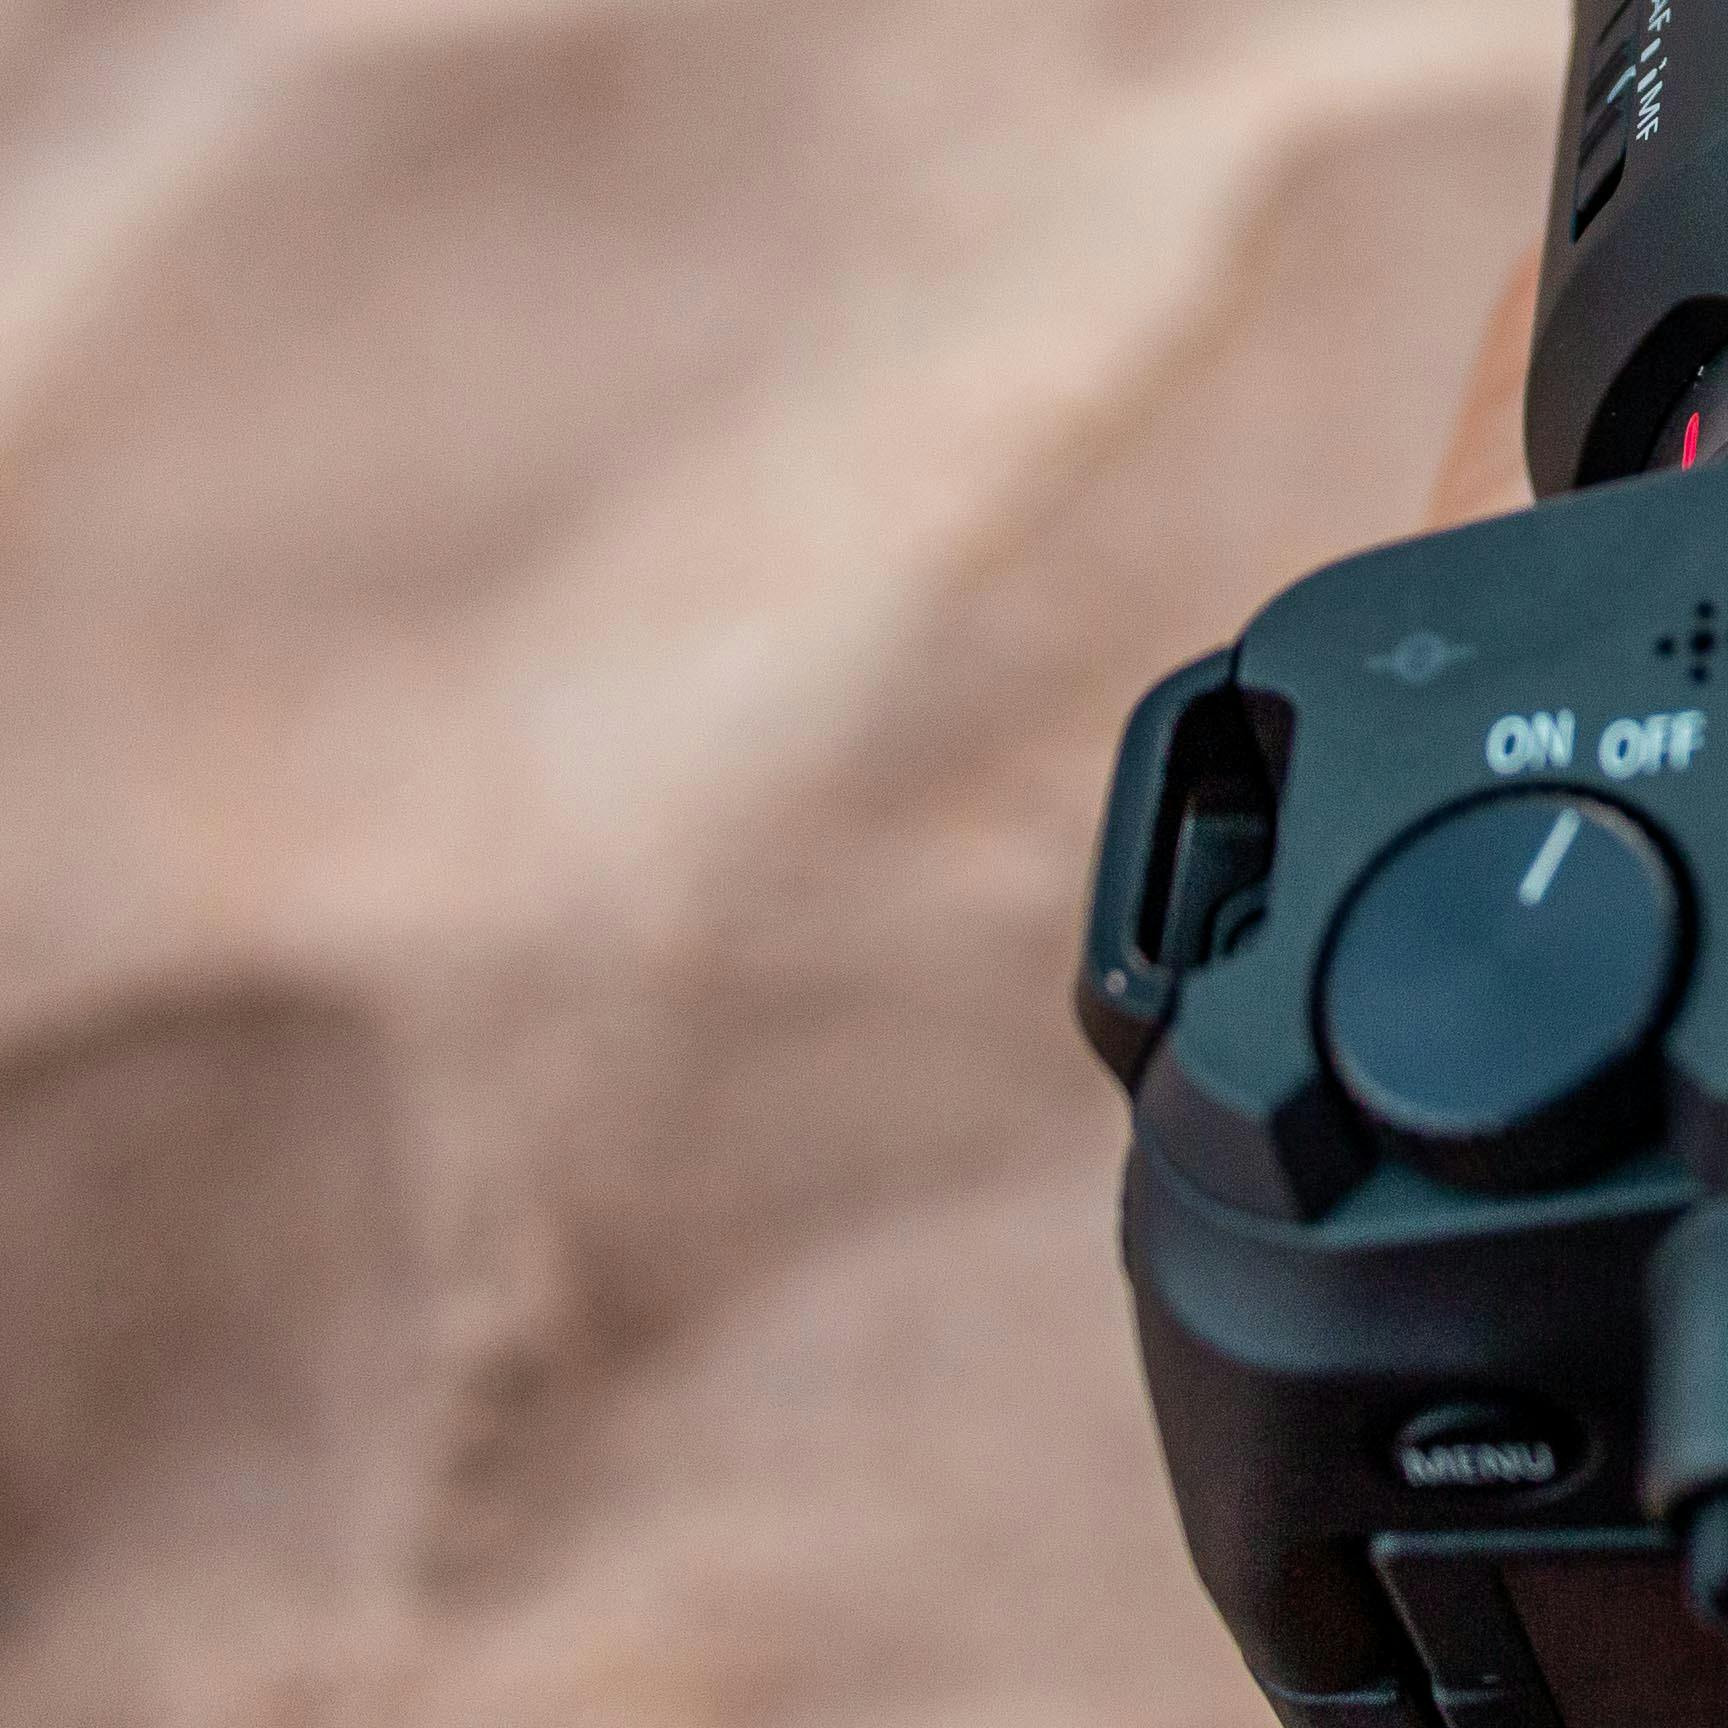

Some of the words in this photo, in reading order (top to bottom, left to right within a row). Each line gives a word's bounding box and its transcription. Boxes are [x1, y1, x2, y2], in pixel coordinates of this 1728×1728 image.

[1635, 80, 1663, 141] MF
[1485, 708, 1576, 774] ON
[1599, 709, 1706, 780] OFF
[1401, 1440, 1557, 1487] MENU
